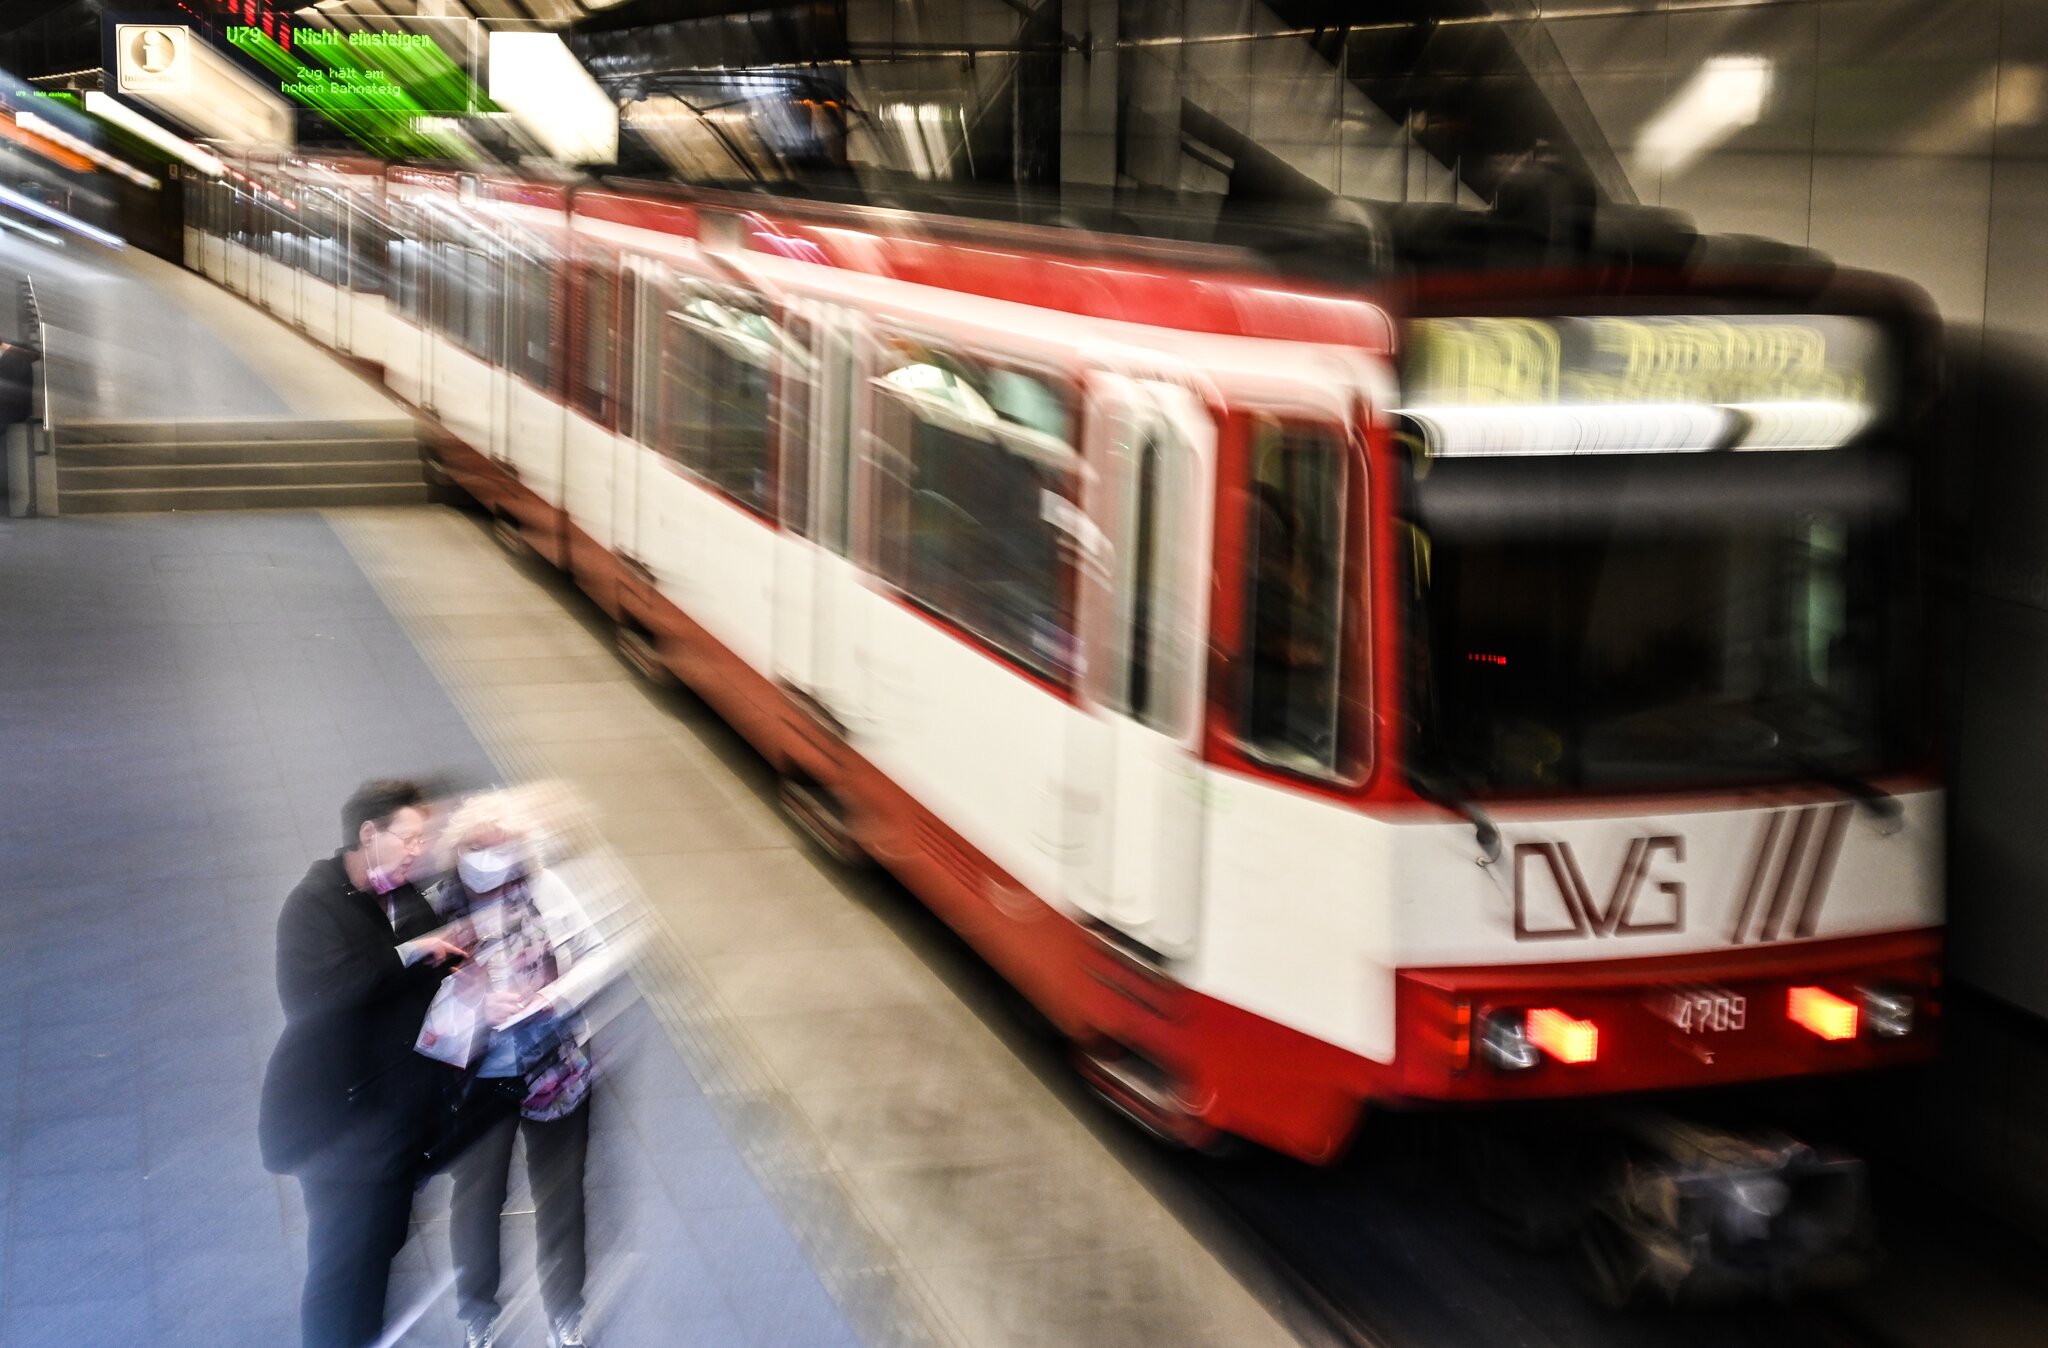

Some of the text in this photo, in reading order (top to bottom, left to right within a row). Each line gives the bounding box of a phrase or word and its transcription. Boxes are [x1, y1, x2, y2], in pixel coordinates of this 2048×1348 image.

[226, 26, 430, 48] U79 Nicht einsteigen
[296, 66, 384, 80] Zug hält am
[281, 82, 401, 97] hohen Bahnsteig
[1514, 834, 1687, 942] DVG
[1675, 996, 1747, 1034] 4709
